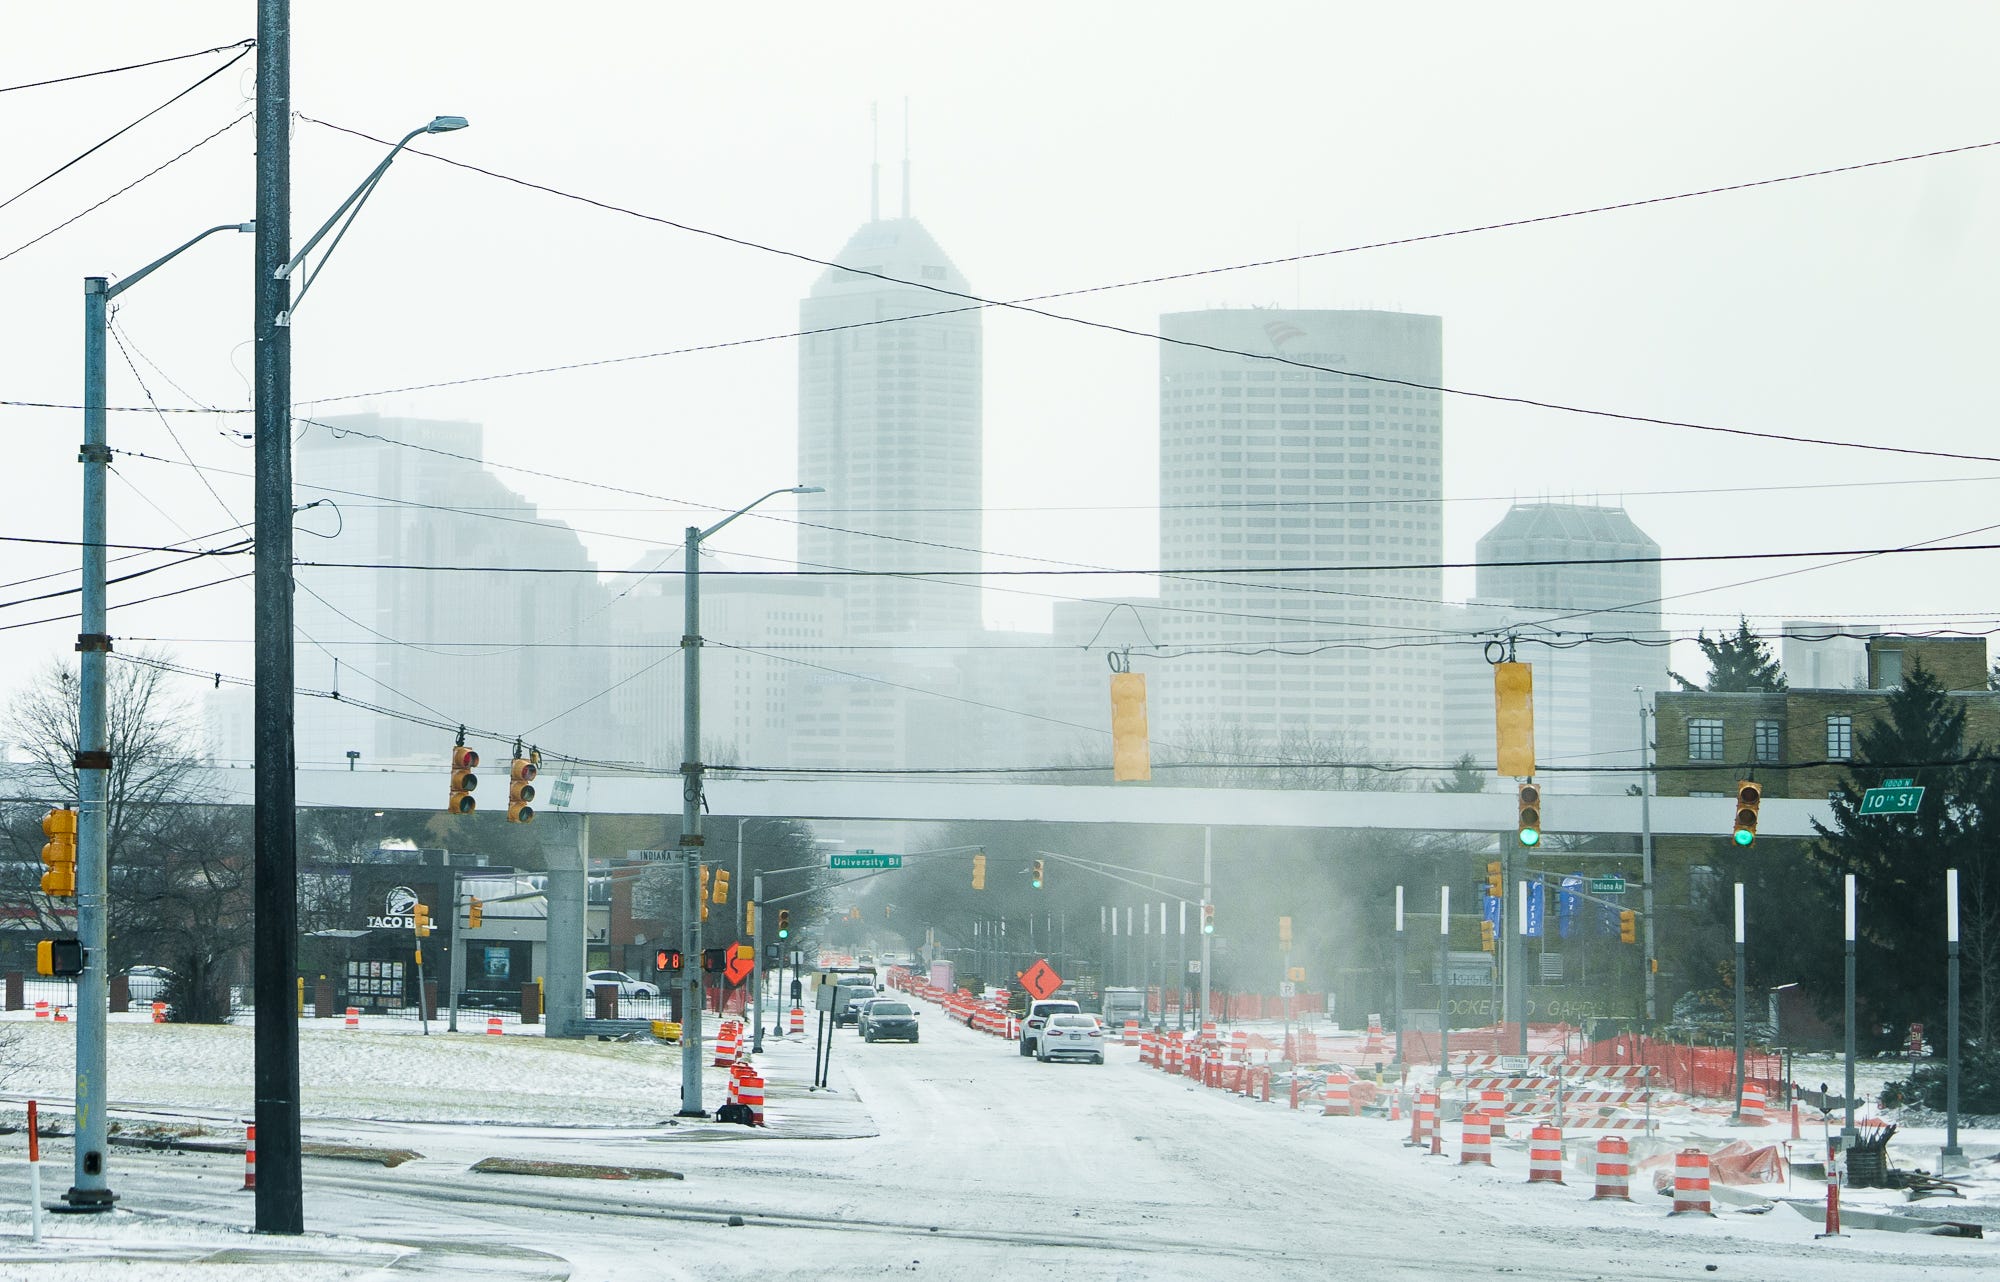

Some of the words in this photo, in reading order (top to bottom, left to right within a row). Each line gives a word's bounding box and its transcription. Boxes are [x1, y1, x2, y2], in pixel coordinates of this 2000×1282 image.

[1868, 795, 1895, 808] 10th
[1897, 794, 1914, 807] St
[640, 850, 672, 861] INDIANA
[833, 857, 884, 867] University
[367, 916, 402, 929] TACO
[404, 917, 438, 930] BL
